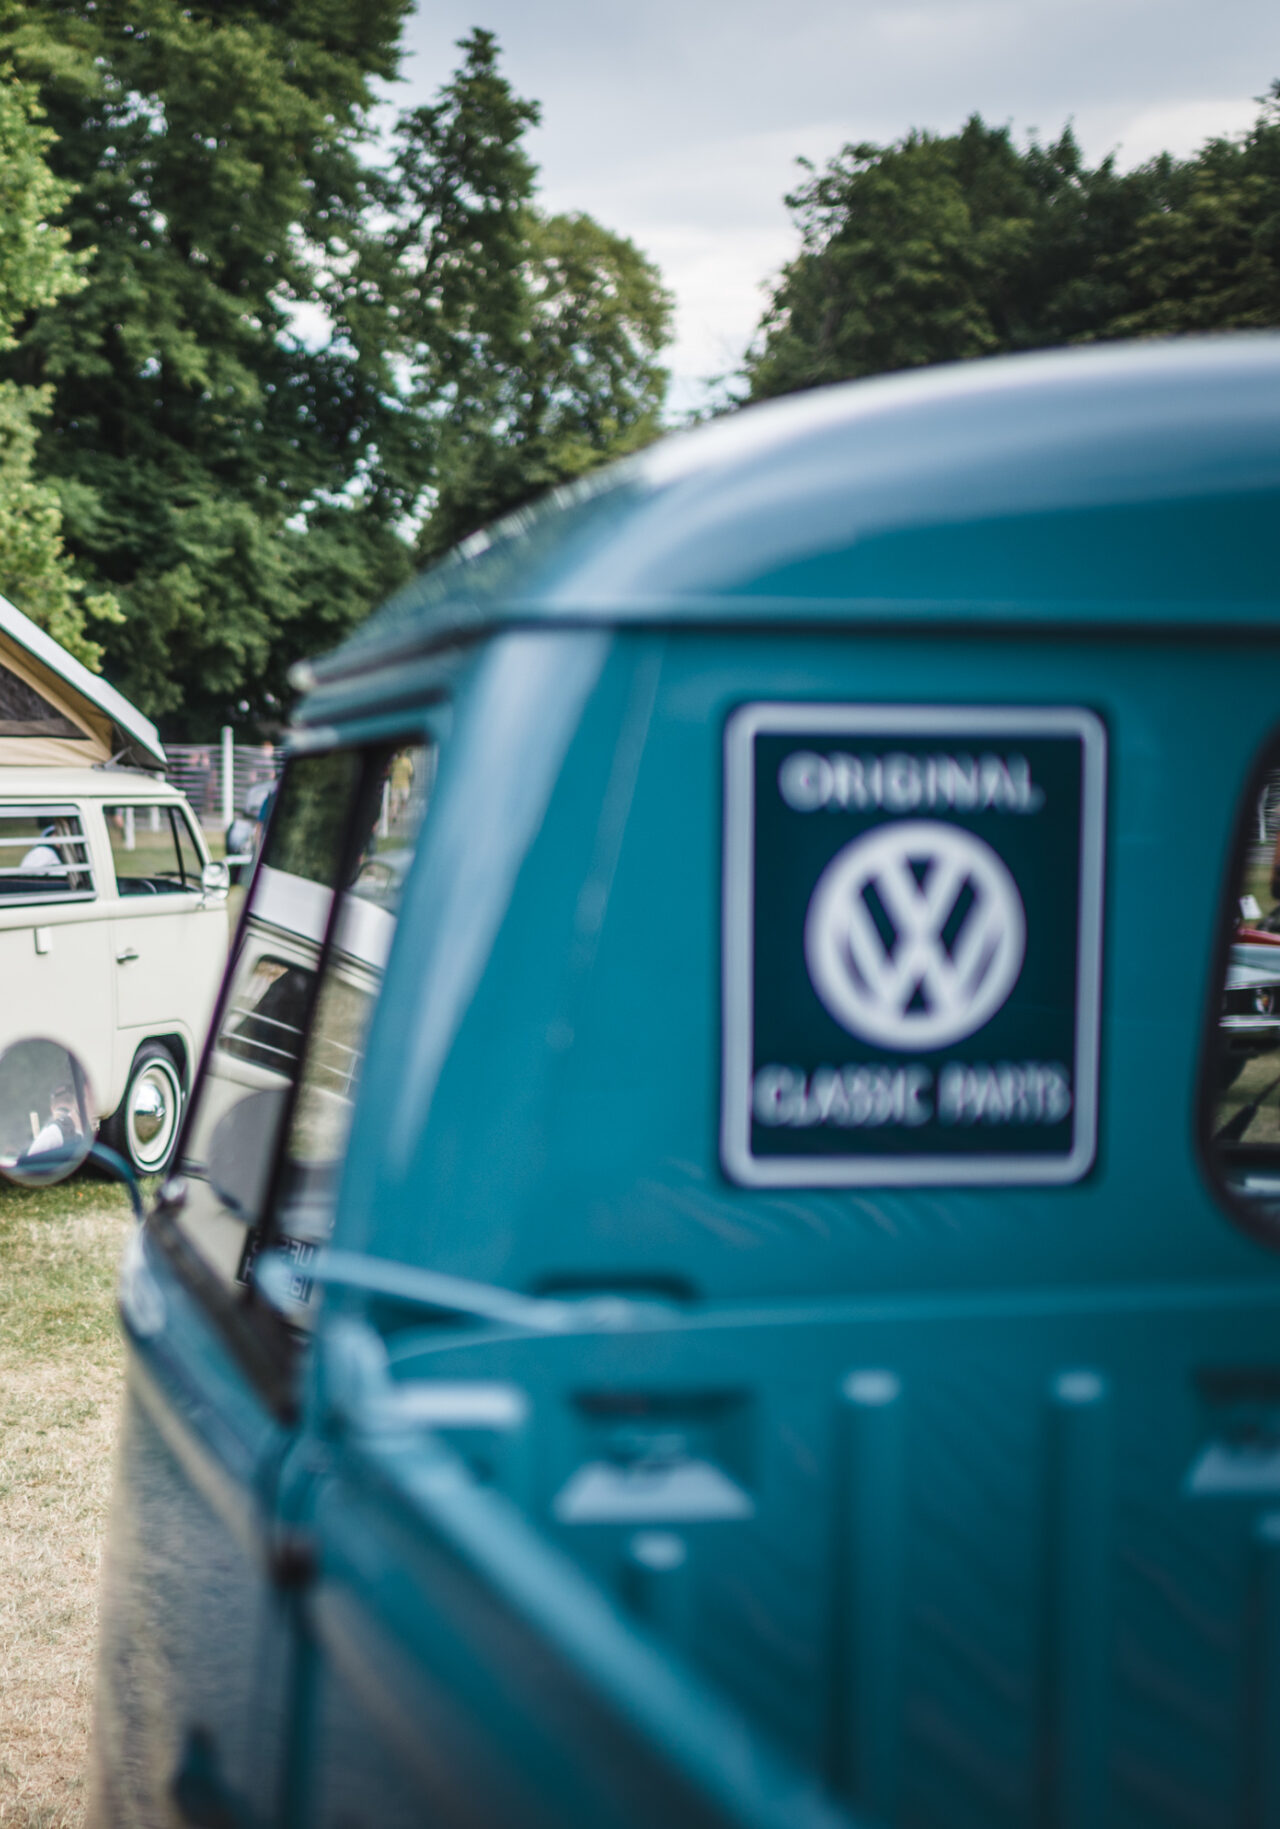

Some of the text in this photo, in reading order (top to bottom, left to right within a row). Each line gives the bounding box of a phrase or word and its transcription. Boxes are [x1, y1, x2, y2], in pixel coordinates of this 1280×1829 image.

[779, 751, 1045, 813] ORIGINAL
[753, 1061, 1071, 1127] CLASSIC PARTS
